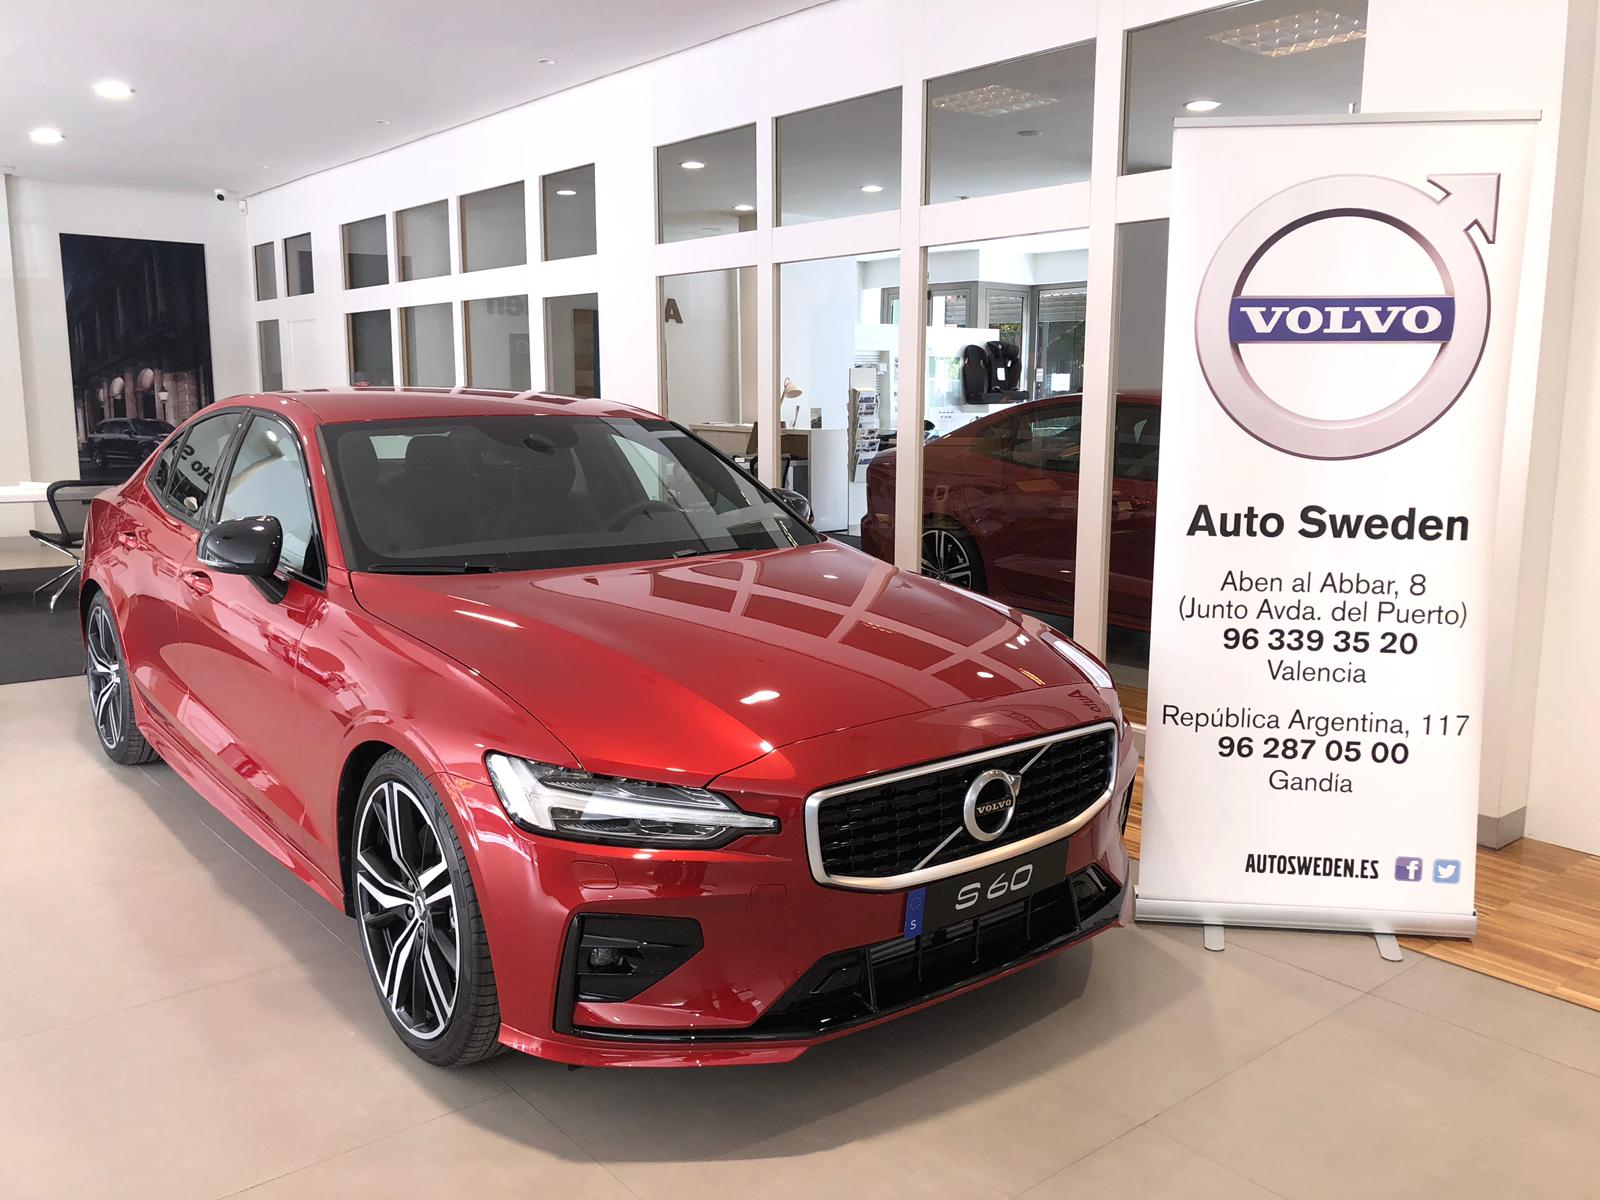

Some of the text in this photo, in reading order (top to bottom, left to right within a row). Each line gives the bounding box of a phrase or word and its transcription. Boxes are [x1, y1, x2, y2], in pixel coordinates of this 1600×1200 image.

[1240, 306, 1442, 334] VOLVO
[1186, 504, 1469, 541] Auto Sweden
[1220, 570, 1426, 600] Aben al Abbar, 8
[1179, 595, 1467, 628] (Junto Avda. del Puerto)
[1223, 628, 1418, 655] 96 339 35 20
[1267, 659, 1367, 684] Valencia
[1162, 704, 1470, 738] República Argentina, 117
[1218, 736, 1409, 765] 96 287 05 00
[1268, 770, 1353, 793] Gandía
[976, 799, 1013, 814] VOLVO
[1245, 854, 1379, 879] AUTOSWEDEN.ES
[909, 919, 917, 930] S
